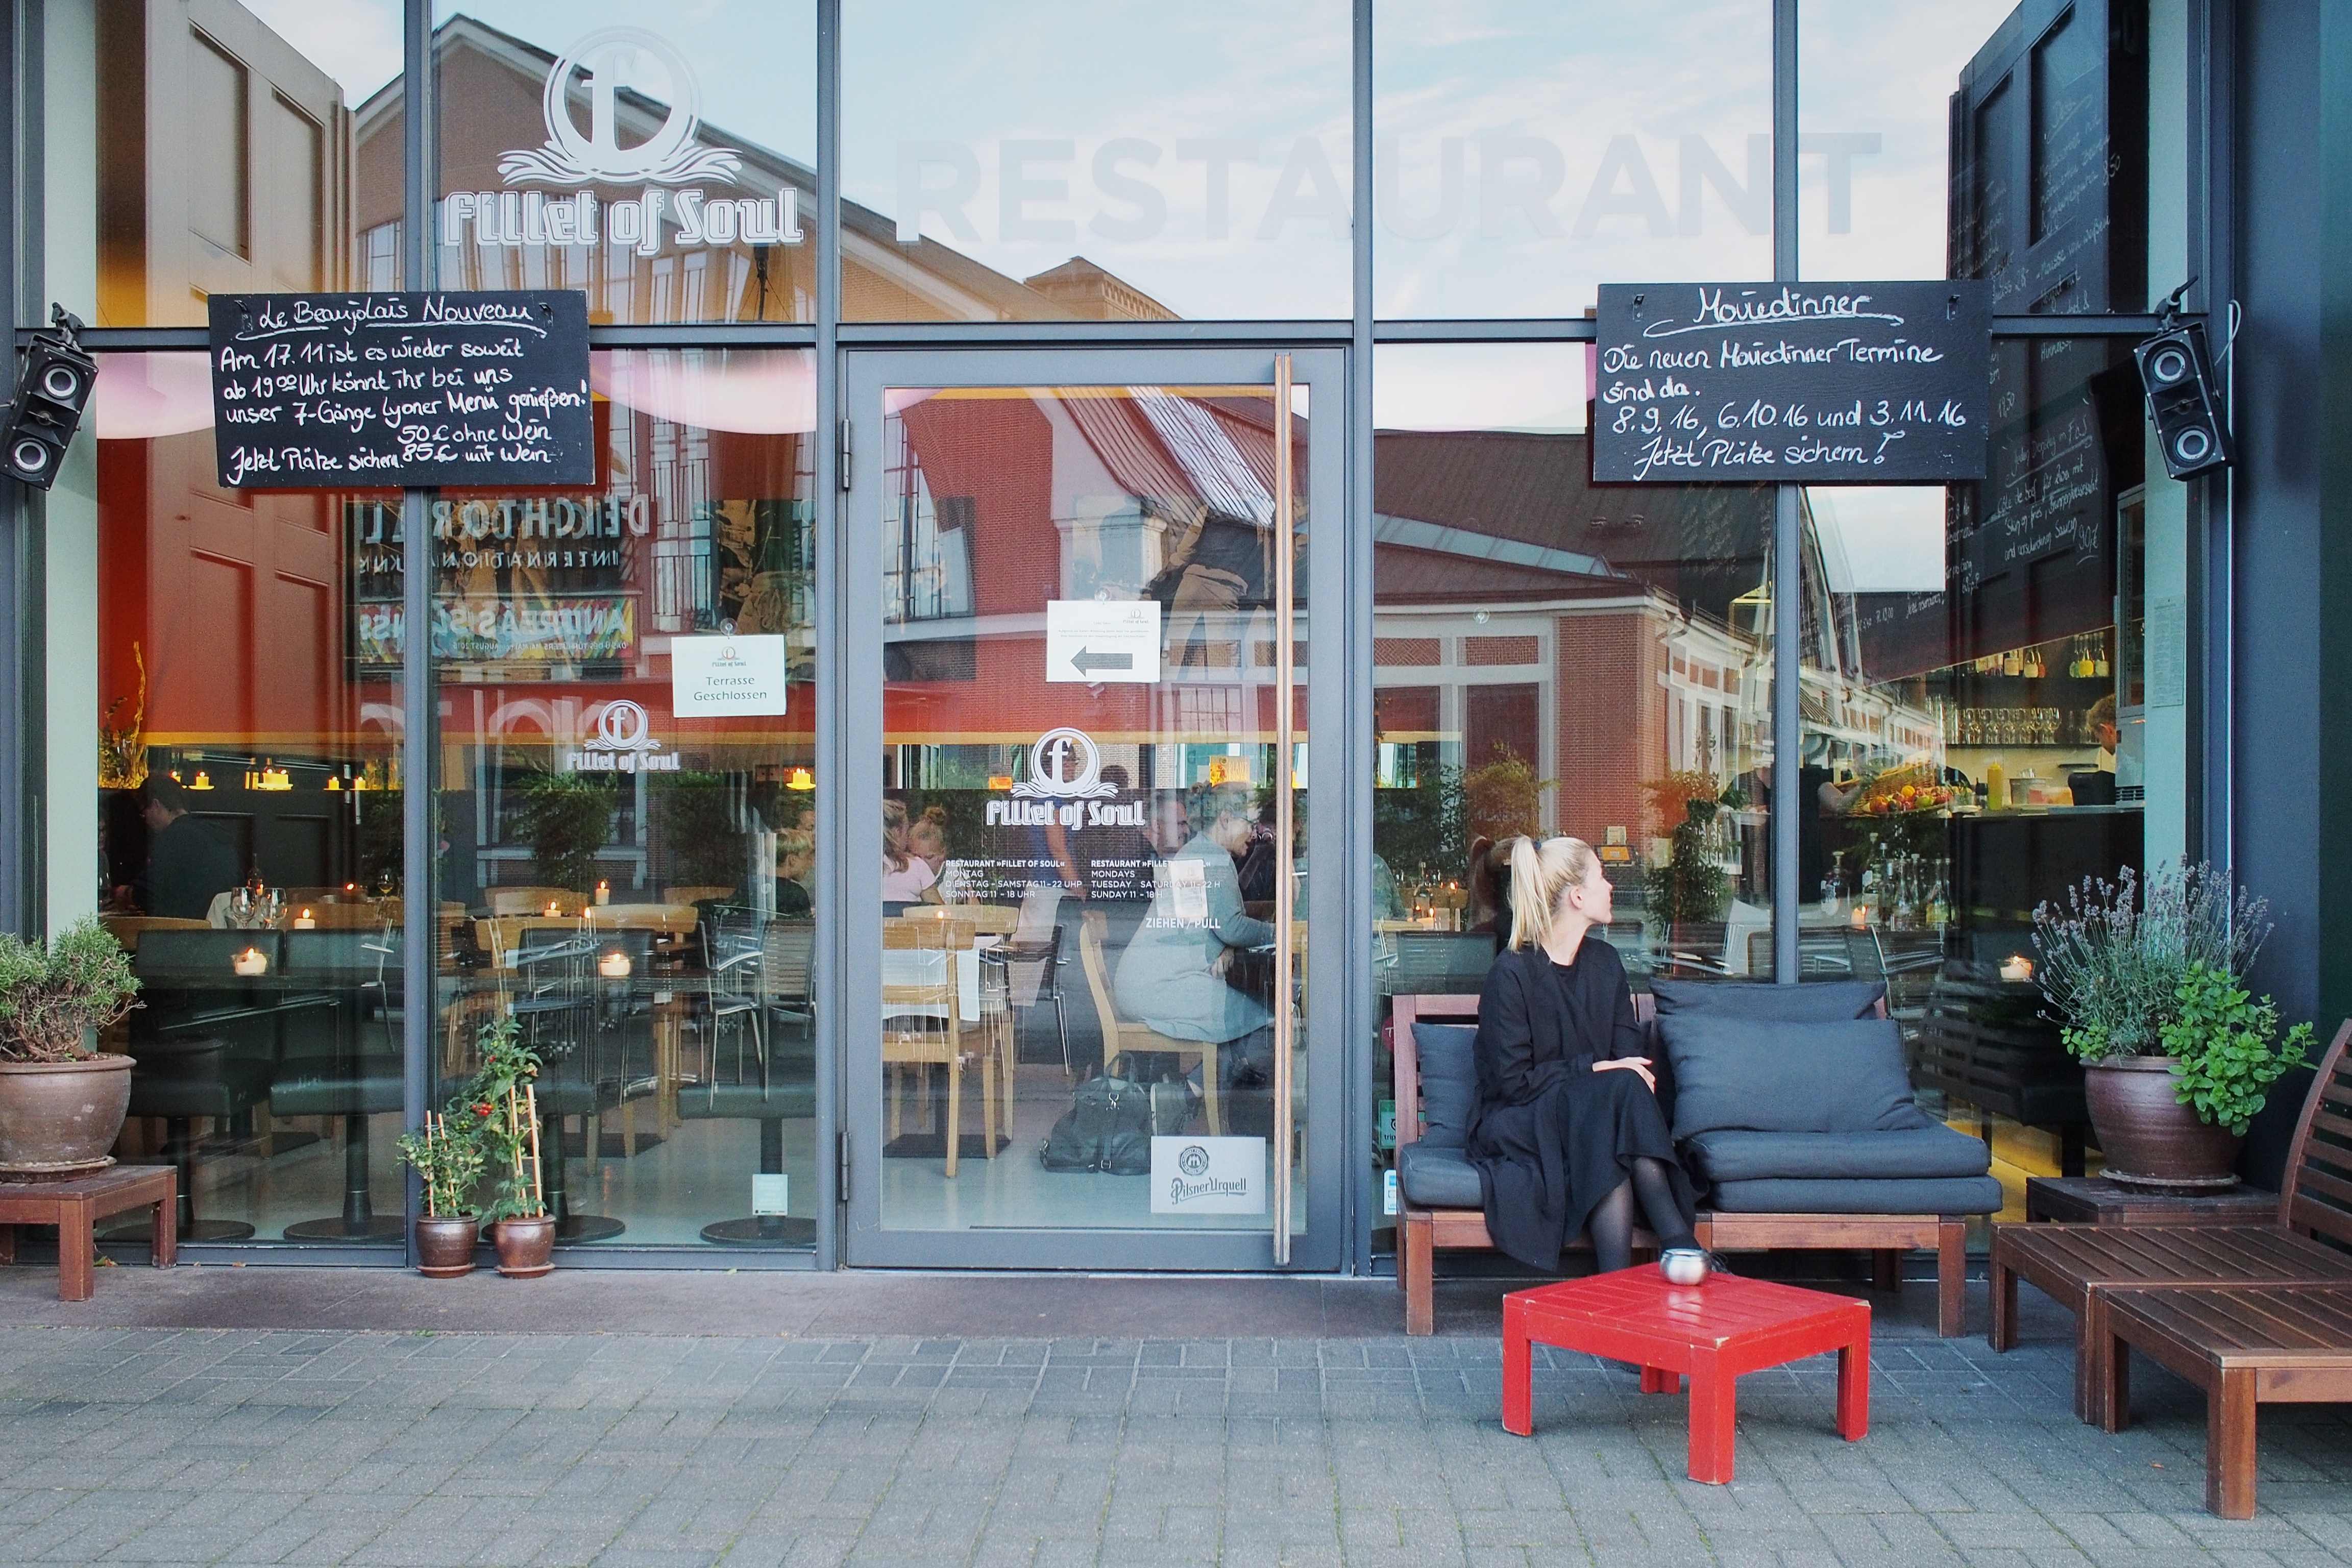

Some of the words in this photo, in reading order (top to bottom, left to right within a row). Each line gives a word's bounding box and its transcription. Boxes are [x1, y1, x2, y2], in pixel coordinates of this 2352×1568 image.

[896, 132, 1882, 244] RESTAURANT
[609, 189, 664, 255] of
[675, 187, 804, 244] Soul
[260, 300, 287, 329] Le
[293, 297, 409, 335] Beaujolais
[423, 296, 533, 322] Nouveau
[1693, 286, 1872, 323] Moviedinner
[221, 347, 261, 372] Am
[327, 341, 358, 363] ist
[365, 347, 387, 361] es
[391, 336, 453, 358] wieder
[461, 337, 524, 357] soweit
[1604, 344, 1644, 374] Die
[1649, 350, 1711, 369] neuen
[1720, 339, 1837, 369] Moviedinner
[1837, 338, 1944, 363] Termine
[224, 379, 247, 400] ab
[300, 373, 328, 396] Uhr
[332, 370, 390, 393] könnt
[391, 368, 426, 390] ihr
[432, 366, 464, 387] bei
[474, 368, 513, 385] uns
[1603, 378, 1655, 404] sind
[1659, 376, 1701, 398] da.
[226, 406, 282, 424] unser
[292, 400, 377, 433] 7-Gänge
[447, 385, 499, 414] Menü
[1817, 400, 1861, 427] und
[452, 423, 499, 443] ohne
[502, 419, 552, 441] Wein
[227, 446, 281, 485] Jetzt
[281, 447, 343, 471] Plätze
[465, 444, 495, 462] mit
[500, 440, 551, 463] Wein
[1633, 435, 1702, 481] Jetzt
[1702, 439, 1776, 468] Plätze
[706, 676, 755, 685] Terrasse
[694, 691, 767, 701] Geschlossen
[619, 752, 637, 773] of
[639, 752, 680, 770] Soul
[1229, 762, 1247, 773] PLANT
[1059, 800, 1085, 830] of
[1088, 800, 1145, 826] Soul
[1145, 918, 1184, 928] ZIEHEN
[1195, 918, 1221, 929] PULL
[1171, 1177, 1209, 1205] Pilsner
[1209, 1177, 1246, 1196] Urquell
